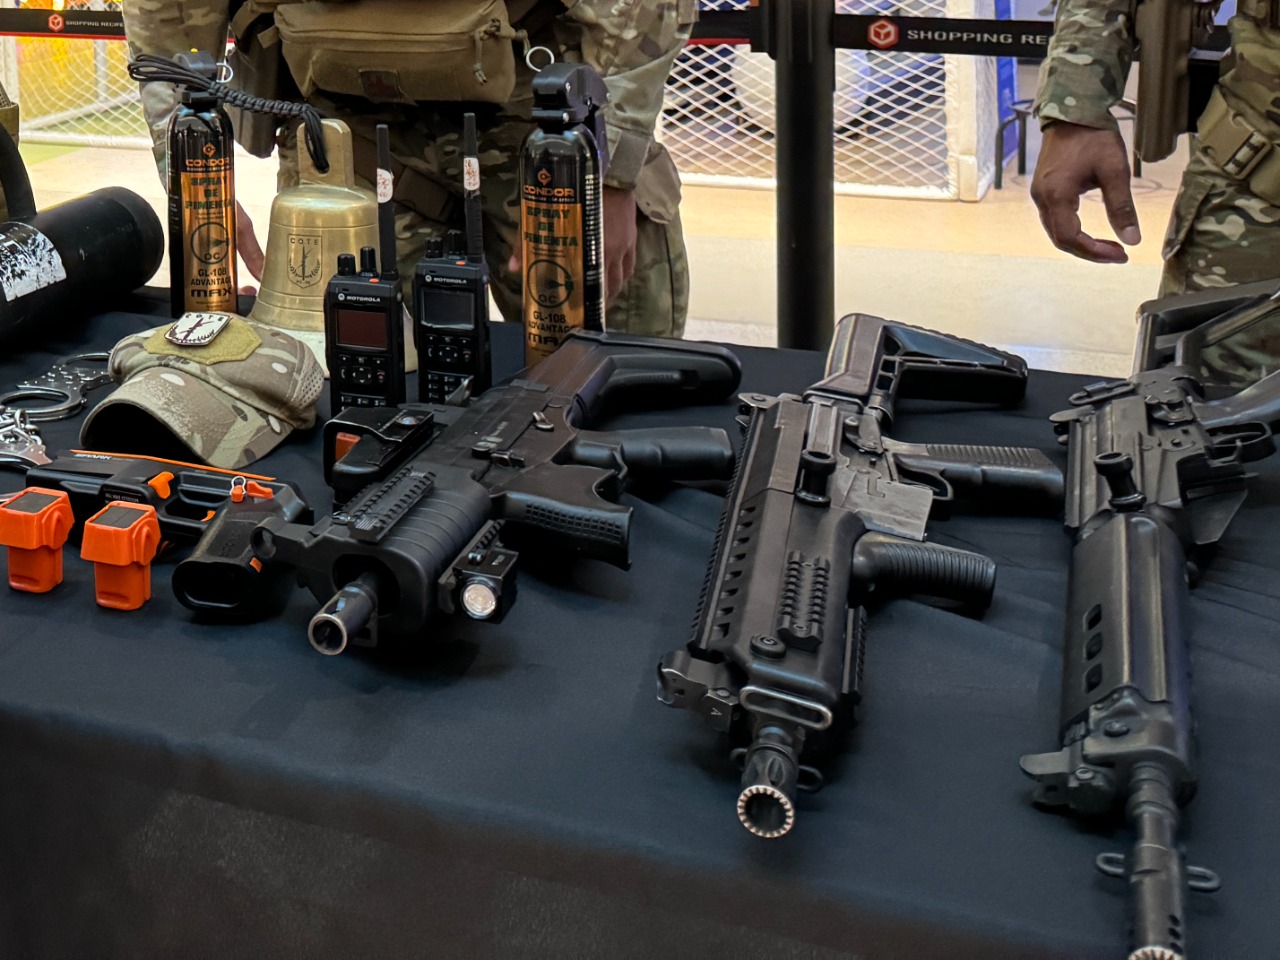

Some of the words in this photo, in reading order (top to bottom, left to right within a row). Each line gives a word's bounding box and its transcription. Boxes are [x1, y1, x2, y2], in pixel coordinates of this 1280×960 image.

[907, 29, 1013, 44] SHOPPING
[1021, 35, 1050, 45] RE
[185, 159, 230, 167] CONDOR
[191, 178, 228, 186] SPRAY
[203, 189, 218, 198] DE
[523, 185, 574, 197] CONDOR
[185, 201, 232, 210] PIMENTA
[526, 208, 570, 219] SPRAY
[204, 252, 220, 260] OC
[198, 269, 227, 277] GL-108
[539, 294, 557, 304] OC
[184, 313, 225, 323] COTE
[533, 310, 566, 324] GL-108
[528, 333, 560, 346] MA
